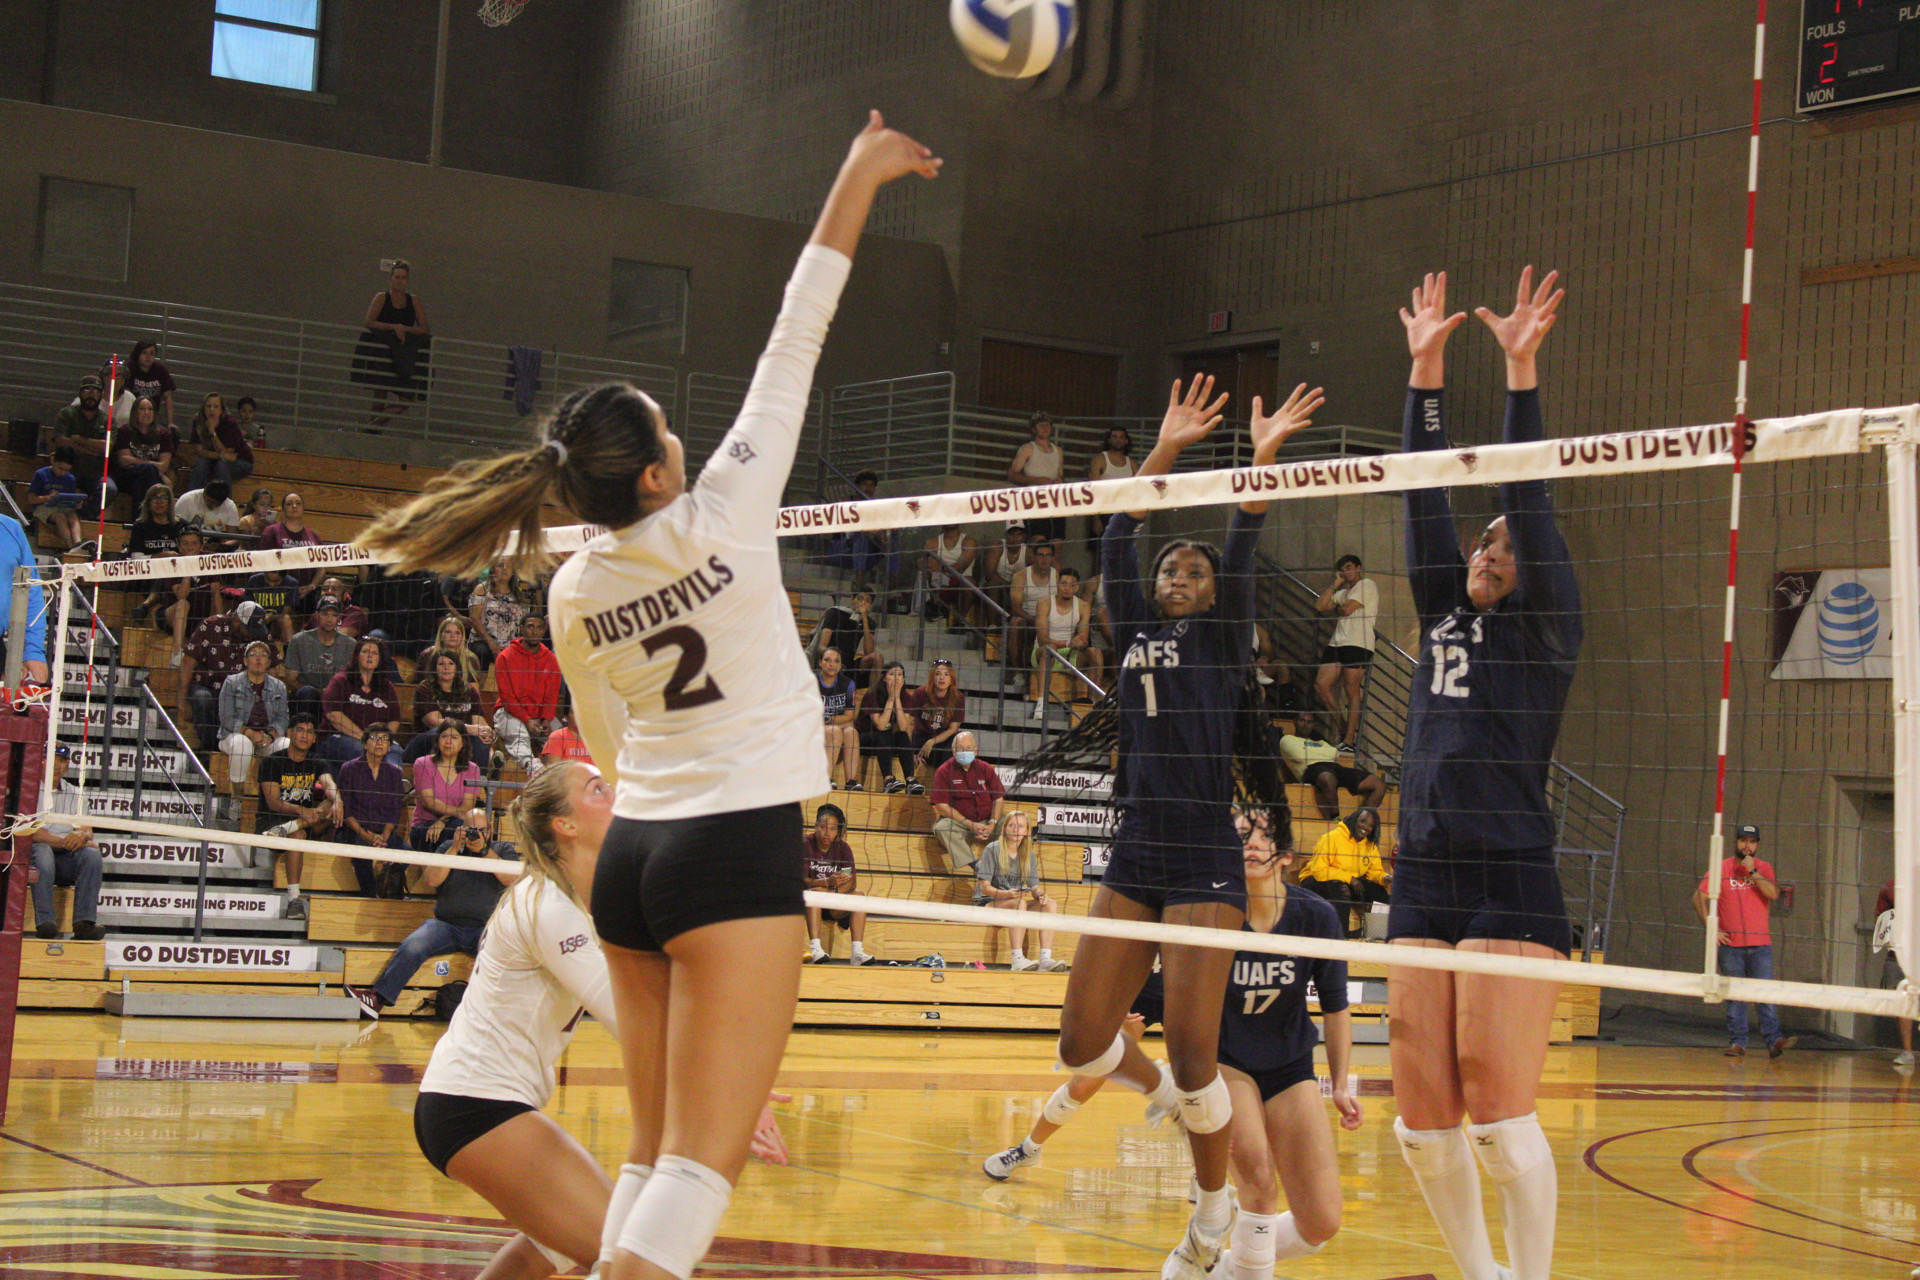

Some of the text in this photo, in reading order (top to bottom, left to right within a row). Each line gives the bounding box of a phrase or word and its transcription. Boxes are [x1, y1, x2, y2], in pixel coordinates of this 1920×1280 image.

[1807, 20, 1846, 40] FOULS
[1819, 41, 1838, 84] 2
[1806, 87, 1835, 105] WON
[1424, 398, 1441, 432] UAFS
[1559, 422, 1758, 466] DUSTDEVILS
[1231, 457, 1385, 493] DUSTDEVILS
[969, 484, 1094, 515] DUSTDEVILS
[776, 504, 861, 530] STDEVILS
[103, 560, 151, 577] DUSTDEVILS
[198, 552, 253, 571] DUSTDEVILS
[582, 554, 735, 648] DUSTDEVILS
[640, 623, 727, 712] 2
[1430, 644, 1470, 698] 12
[1140, 673, 1158, 717] 1
[97, 895, 122, 908] UTH
[229, 900, 266, 912] PRIDE
[122, 945, 291, 966] GO DUSTDEVILS!
[1233, 960, 1296, 986] UAFS
[1243, 988, 1281, 1015] 17
